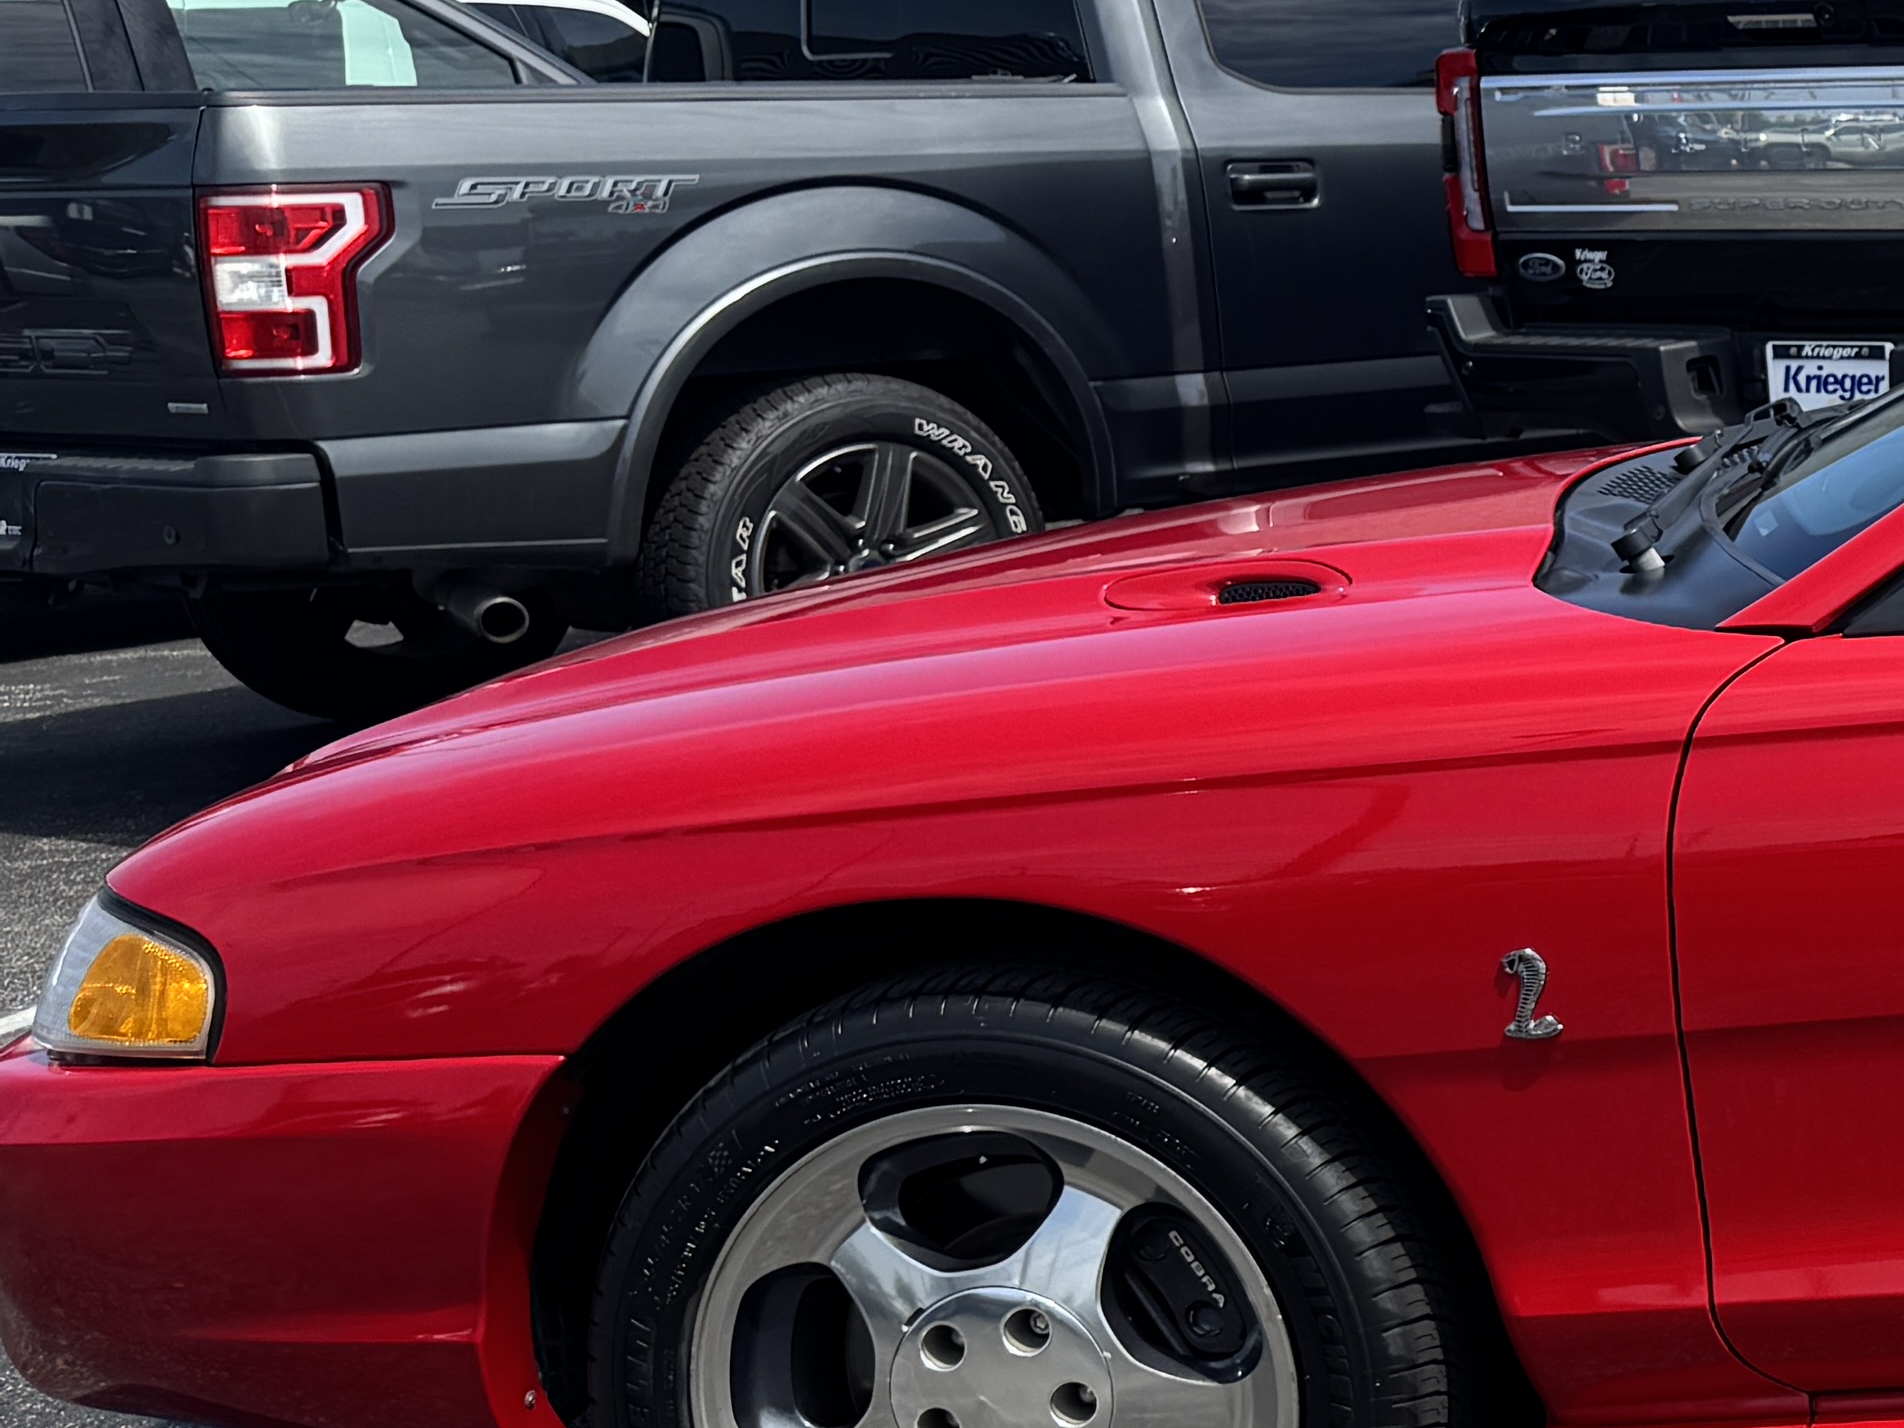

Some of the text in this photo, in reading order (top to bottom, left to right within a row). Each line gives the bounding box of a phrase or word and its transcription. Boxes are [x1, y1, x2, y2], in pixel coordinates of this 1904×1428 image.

[432, 173, 700, 209] SPORT
[1801, 343, 1859, 360] Krieger
[1783, 364, 1886, 402] Krieger
[914, 418, 1028, 534] WRANG
[1168, 1230, 1226, 1309] COBRA
